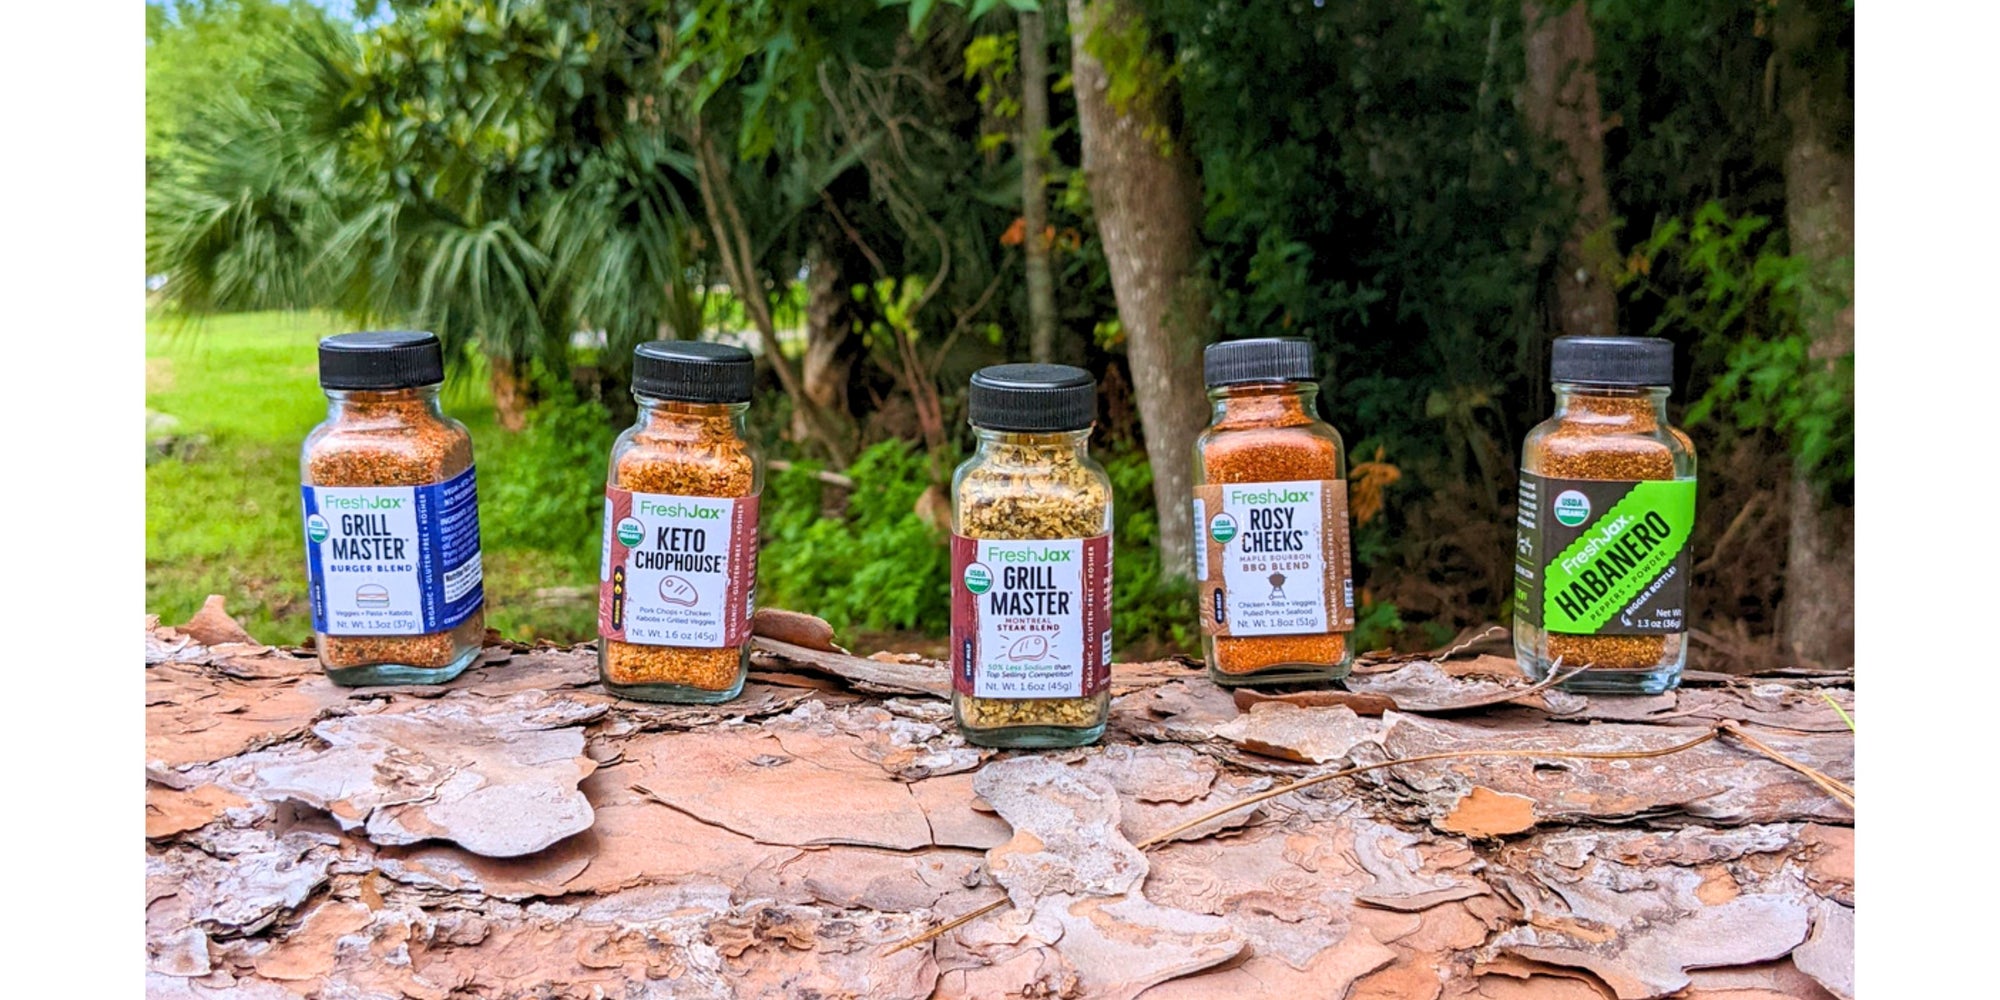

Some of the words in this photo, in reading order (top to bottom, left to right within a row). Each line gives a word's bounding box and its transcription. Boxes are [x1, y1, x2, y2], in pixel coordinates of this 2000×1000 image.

[325, 495, 400, 509] FreshJax
[1232, 489, 1308, 504] FreshJax
[419, 494, 428, 524] KOSHER
[641, 501, 719, 519] FreshJax
[1250, 507, 1294, 530] ROSY
[342, 514, 392, 536] GRILL
[332, 538, 405, 560] MASTER
[657, 526, 706, 553] KETO
[1243, 530, 1303, 553] CHEEKS
[422, 533, 433, 584] GLUTEN-FREE
[635, 551, 721, 573] CHOPHOUSE
[988, 547, 1071, 562] FreshJax
[733, 544, 742, 595] GLUTEN-FREE
[1243, 564, 1266, 572] BBQ
[1554, 510, 1671, 622] HABANERO
[1004, 566, 1057, 590] GRILL
[1591, 588, 1625, 621] PEPPERS
[1633, 550, 1666, 584] POWDER
[1626, 589, 1653, 616] BIGGER
[1649, 566, 1677, 593] BOTTLE!
[426, 592, 435, 627] ORGANIC
[656, 607, 678, 616] Chops
[991, 592, 1069, 615] MASTER
[1656, 609, 1671, 617] Net
[393, 619, 416, 630] (37g)
[1296, 617, 1318, 626] (51g)
[695, 632, 717, 642] (45g)
[1002, 671, 1026, 679] Selling
[1048, 682, 1072, 691] (45g)
